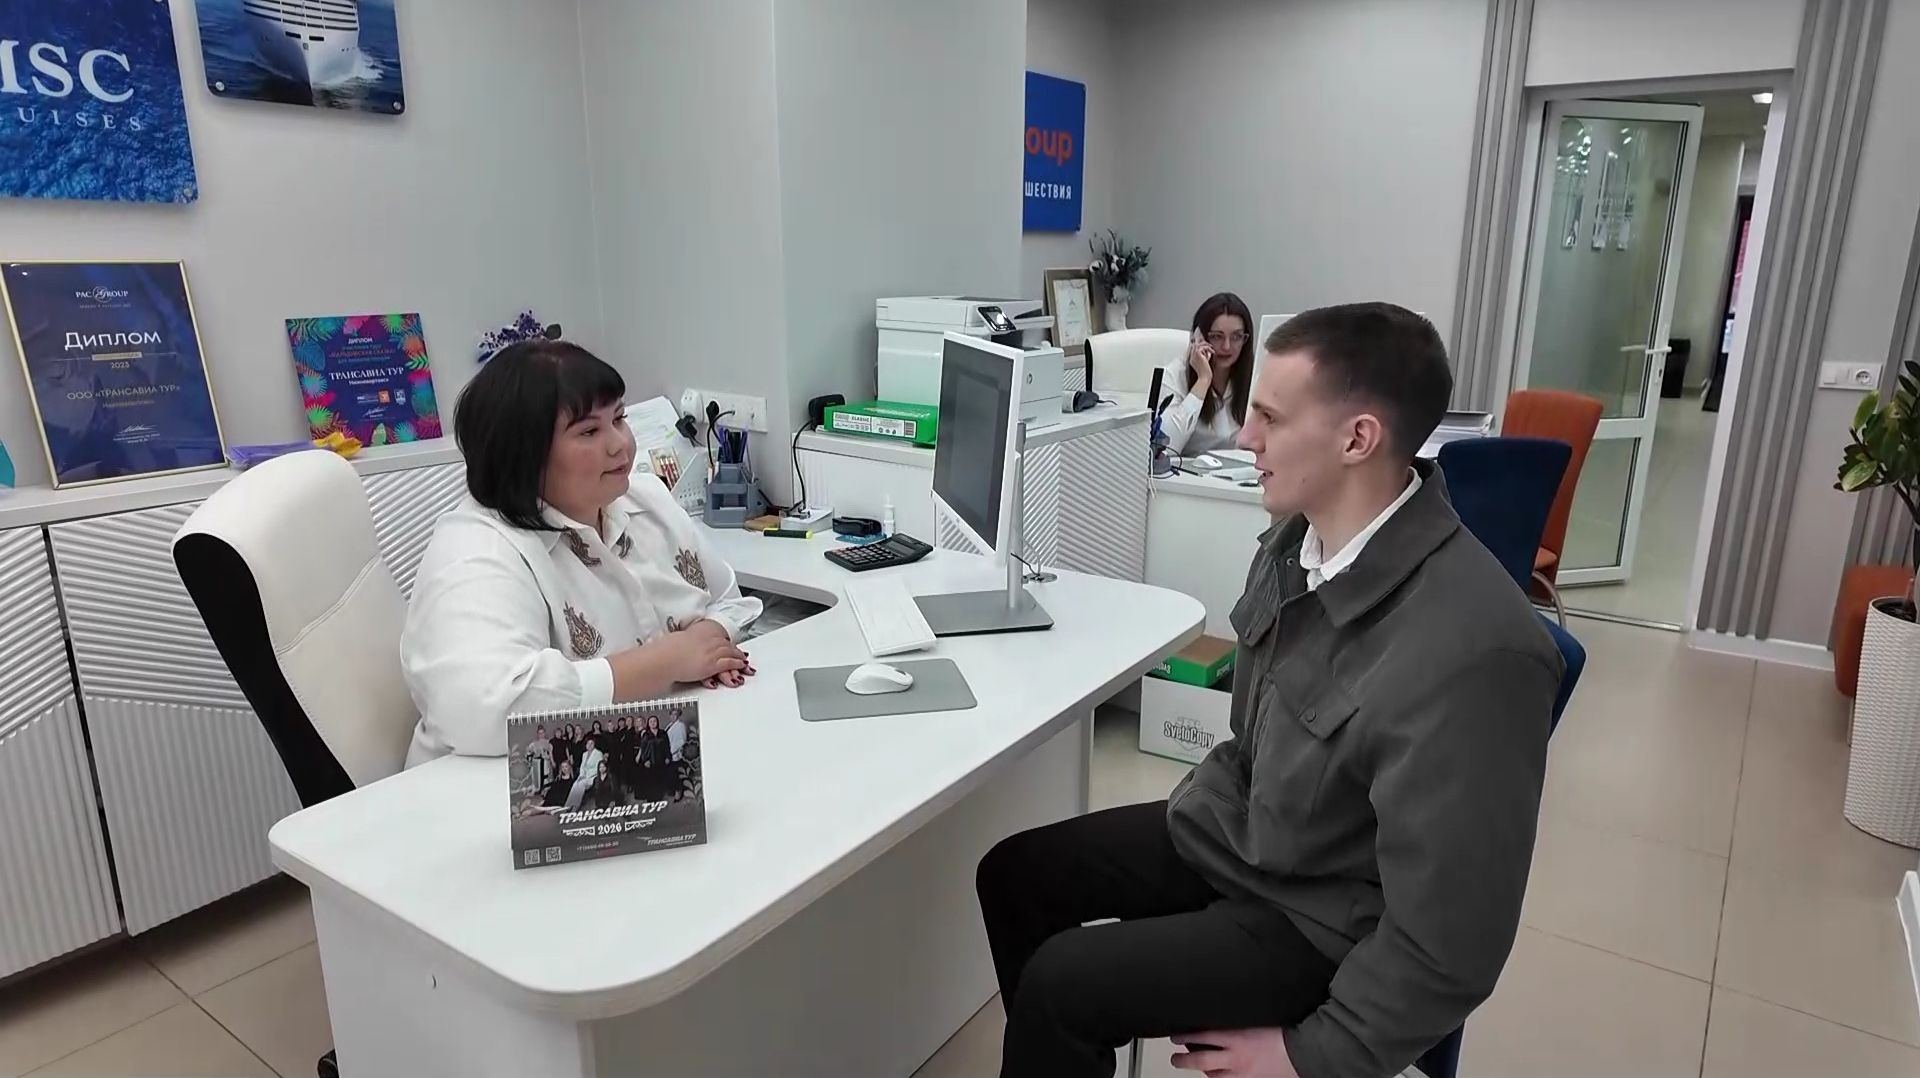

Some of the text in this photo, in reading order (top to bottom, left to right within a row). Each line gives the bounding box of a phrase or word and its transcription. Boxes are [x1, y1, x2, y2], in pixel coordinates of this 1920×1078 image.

[0, 106, 142, 132] UISES
[1025, 126, 1072, 167] oup
[1025, 181, 1071, 200] ШЕСТВИЯ
[64, 331, 161, 350] Диплом
[329, 367, 404, 380] ТРАНСАВИА ТУР
[67, 391, 93, 400] ООО
[1163, 720, 1214, 749] SvetoCopy
[559, 801, 668, 824] ТРАНСАВИА ТУР
[598, 823, 622, 835] 2026
